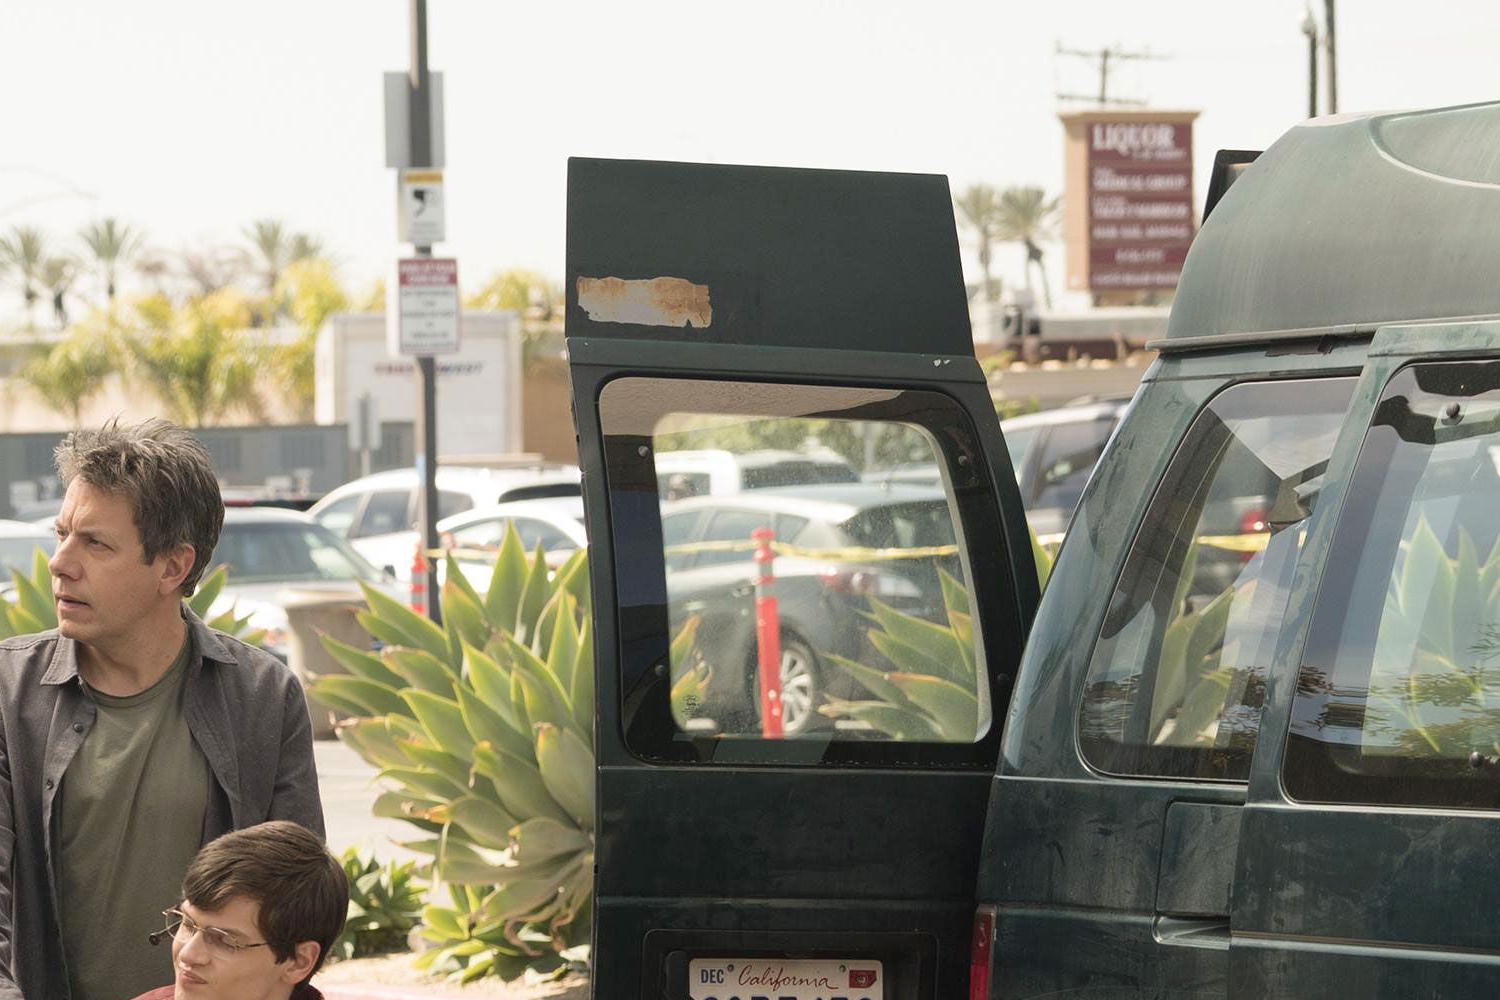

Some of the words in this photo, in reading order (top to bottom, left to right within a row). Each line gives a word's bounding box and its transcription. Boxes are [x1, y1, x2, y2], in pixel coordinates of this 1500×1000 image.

[1093, 124, 1175, 156] LIQUOR
[701, 968, 724, 984] DEC
[738, 965, 838, 992] California
